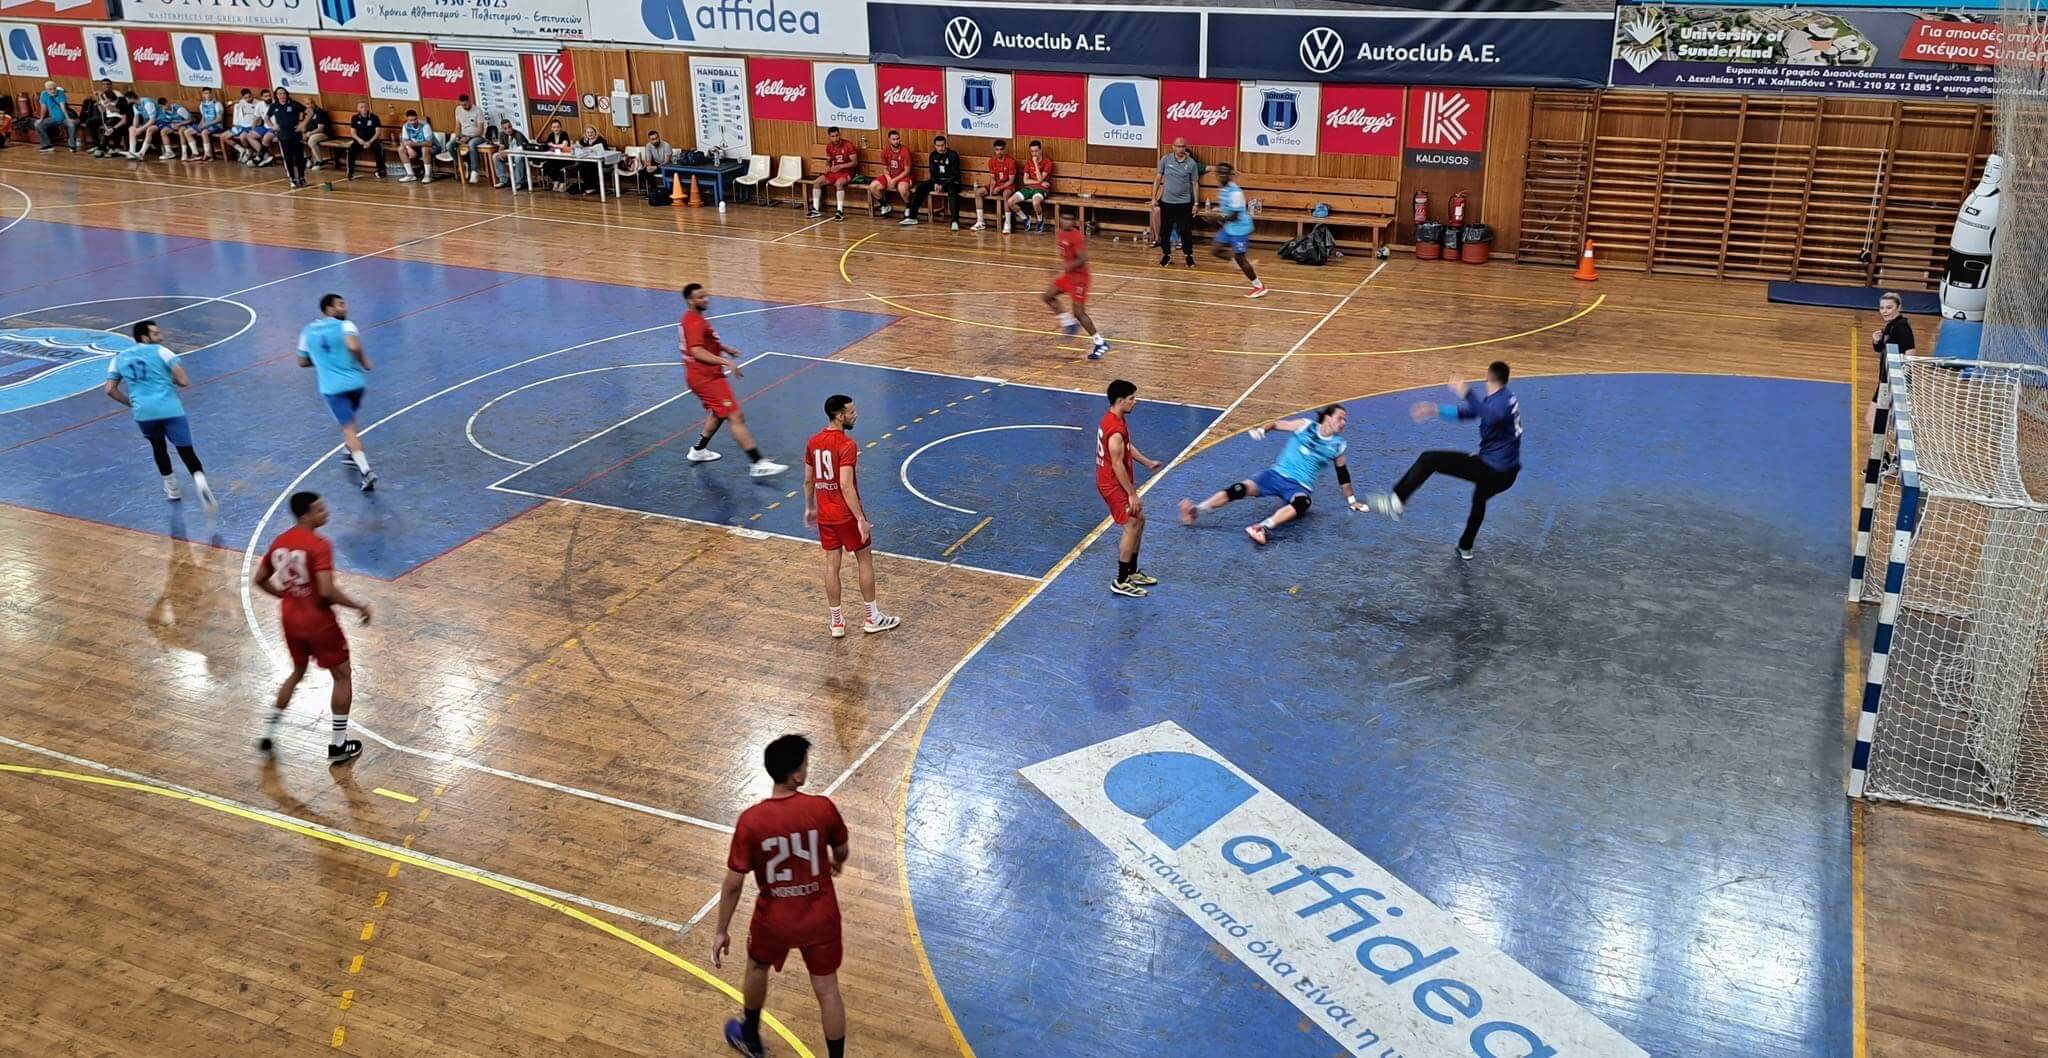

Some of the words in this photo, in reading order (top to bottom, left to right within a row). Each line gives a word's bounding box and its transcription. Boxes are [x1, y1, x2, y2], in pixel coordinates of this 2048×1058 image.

[379, 4, 408, 20] Χρόνια
[411, 6, 460, 22] Αθλητισμού
[471, 8, 522, 25] Πολιτισμού
[696, 0, 819, 34] affidea
[992, 32, 1072, 51] Autoclub
[1076, 36, 1111, 53] A.E.
[1681, 28, 1762, 44] University
[1766, 30, 1783, 42] of
[1920, 25, 1943, 38] Για
[1945, 30, 2004, 44] σπουδές
[48, 42, 82, 62] Kellogg's
[133, 47, 169, 67] Kellogg's
[223, 51, 262, 72] Kellogg's
[1357, 42, 1453, 61] Autoclub
[1457, 47, 1501, 64] A.E.
[1678, 45, 1773, 59] Sunderland
[1916, 43, 1979, 59] σκέψου
[319, 56, 360, 78] Kellogg's
[420, 61, 464, 84] Kellogg's
[475, 59, 514, 68] HANDBALL
[697, 68, 739, 78] HANDBALL
[1688, 75, 1734, 84] Δεκελείας
[1770, 78, 1825, 89] Χαλκηδόνα
[1836, 81, 1860, 89] Τηλ.:
[1863, 82, 1881, 90] 210
[1884, 83, 1896, 91] 92
[1914, 84, 1932, 92] 885
[1726, 66, 1777, 78] Ευρωπαϊκό
[1781, 68, 1820, 80] Γραφείο
[1823, 70, 1886, 82] Διασύνδεσης
[1889, 73, 1905, 81] και
[1908, 73, 1971, 83] Ενημέρωσης
[755, 79, 808, 103] Kellogg's
[884, 86, 940, 111] Kellogg's
[1020, 93, 1080, 119] Kellogg's
[1166, 100, 1232, 126] Kellogg's
[830, 112, 865, 124] affidea
[972, 120, 999, 130] affidea
[1325, 106, 1397, 134] Kellogg's
[1103, 128, 1143, 142] affidea
[1269, 135, 1302, 146] affidea
[1415, 153, 1470, 166] KALOUSOS
[813, 448, 835, 481] 19
[761, 829, 821, 884] 24
[1143, 853, 1202, 900] πάνω
[1200, 902, 1253, 938] από
[1247, 940, 1297, 978] όλα
[1293, 975, 1357, 1029] είναι
[1355, 1028, 1380, 1050] η
[1220, 834, 1558, 1058] affidea
